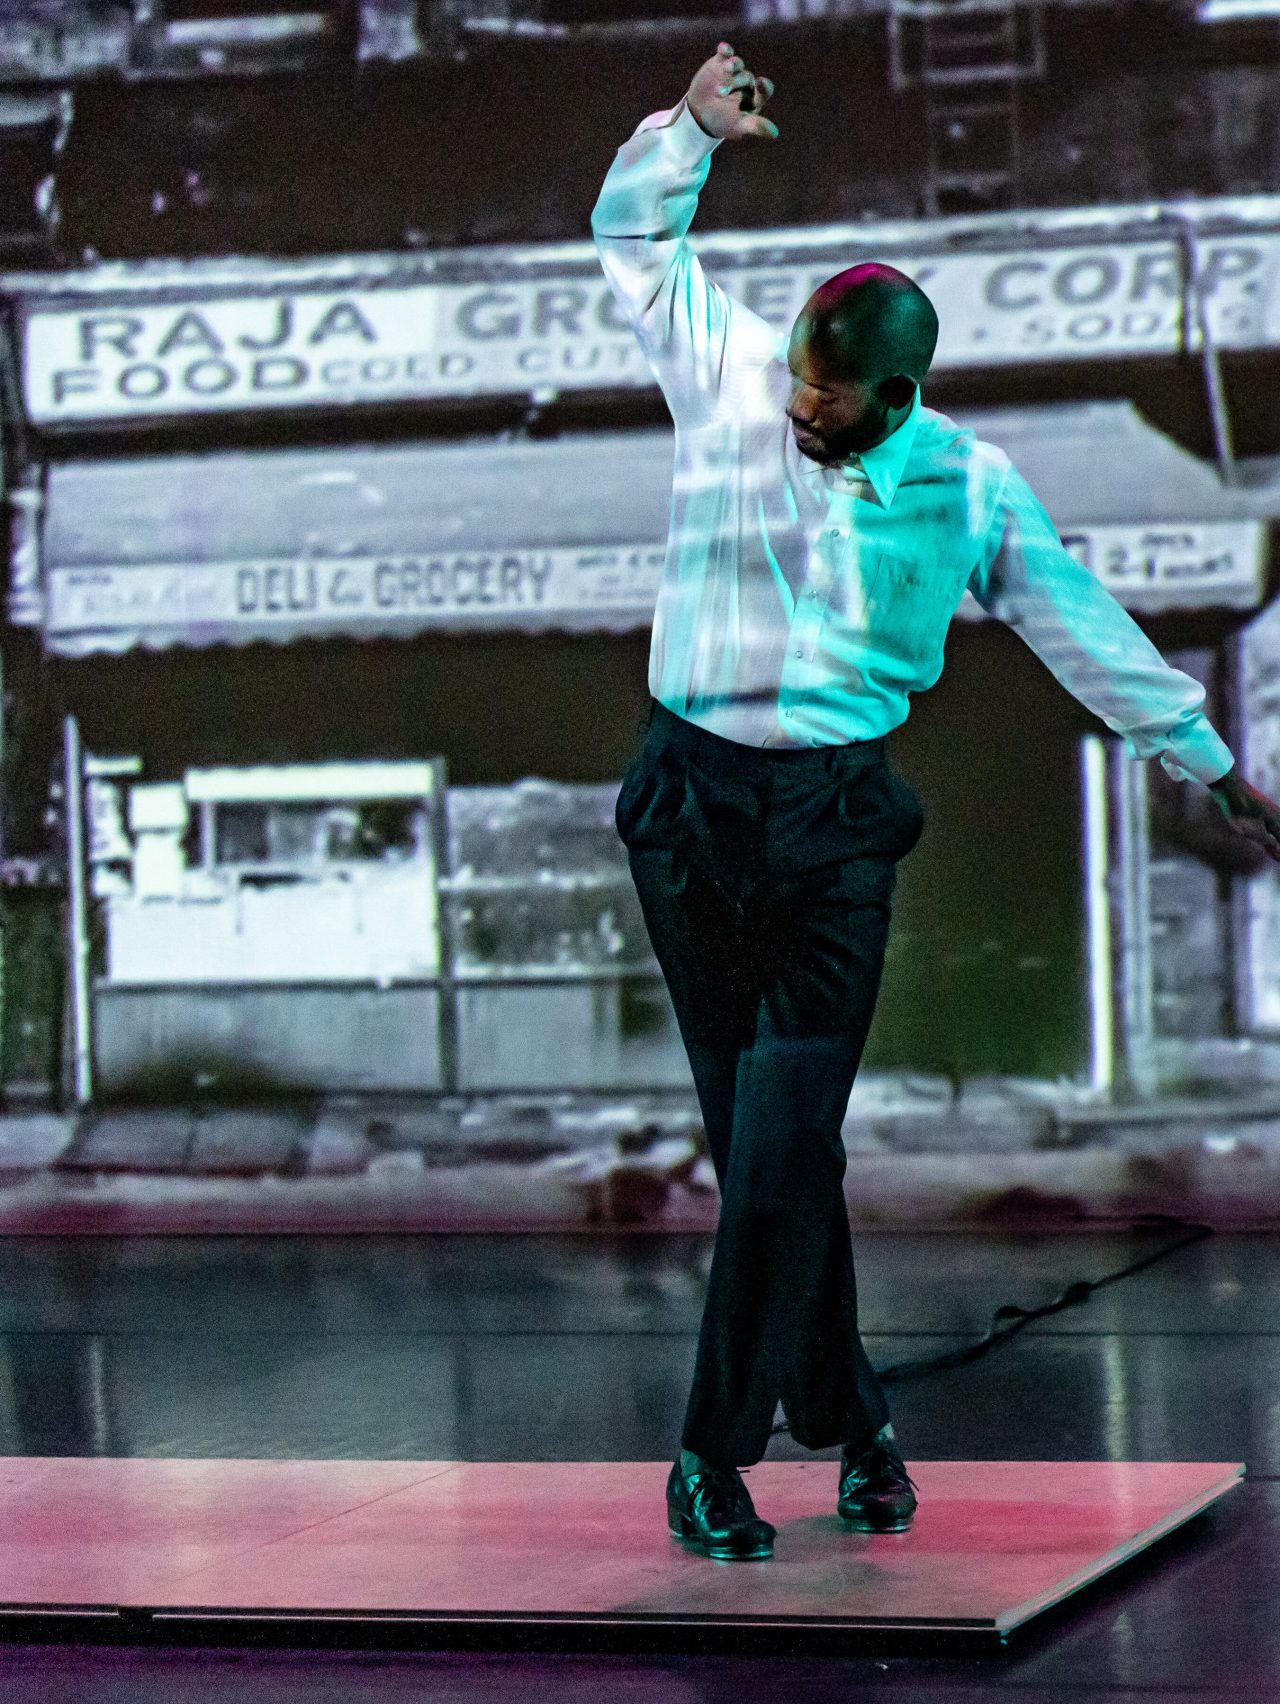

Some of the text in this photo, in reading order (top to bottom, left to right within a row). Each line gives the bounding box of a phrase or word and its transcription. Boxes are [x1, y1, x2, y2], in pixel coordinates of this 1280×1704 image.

[78, 299, 378, 361] RAJA
[52, 355, 311, 405] FOOD
[319, 351, 476, 384] COLD
[237, 564, 318, 614] DELI
[372, 552, 553, 609] GROCERY
